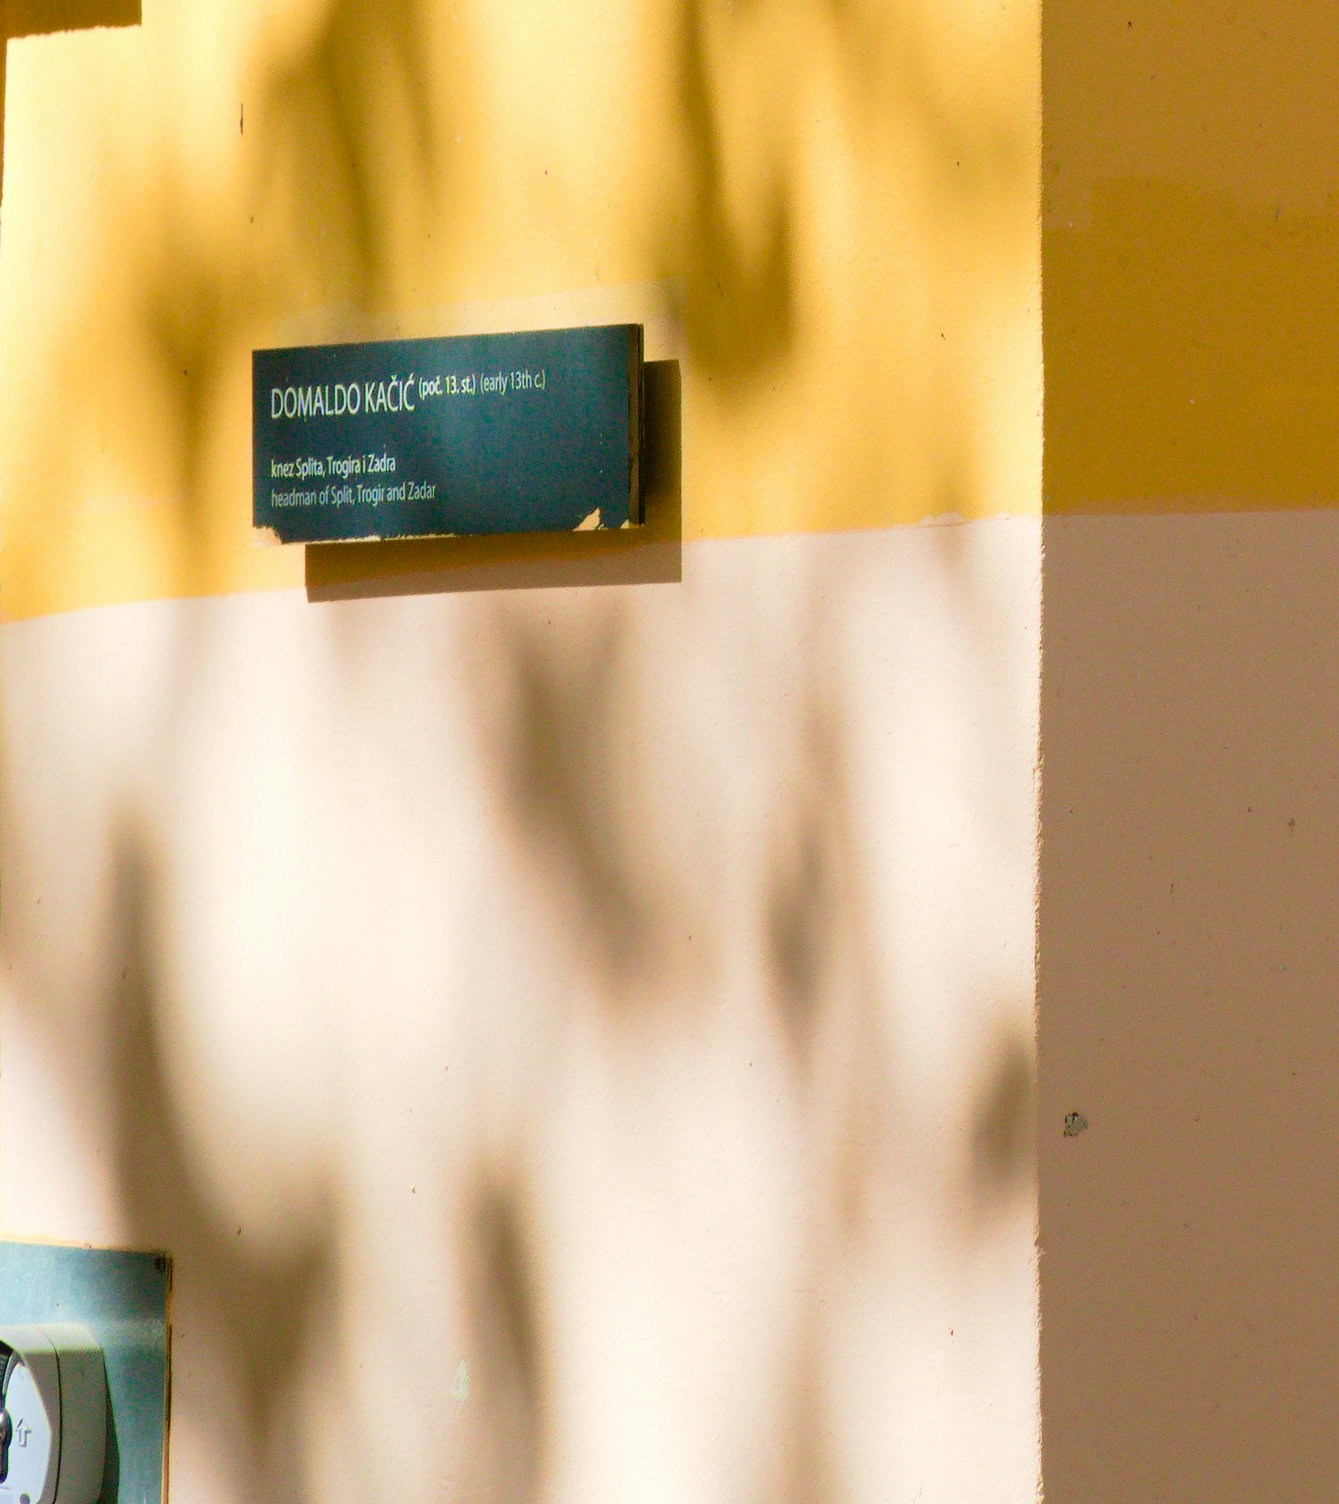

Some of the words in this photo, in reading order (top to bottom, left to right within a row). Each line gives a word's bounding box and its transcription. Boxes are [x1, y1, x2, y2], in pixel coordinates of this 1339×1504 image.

[270, 382, 361, 420] DOMALDO
[364, 372, 416, 414] KAČIĆ
[418, 375, 443, 401] (poč.
[445, 375, 460, 395] 13.
[480, 372, 508, 395] (early
[510, 370, 532, 390] 13th
[270, 459, 295, 478] knez
[295, 456, 326, 481] Splita,
[326, 454, 361, 478] Trogira
[367, 452, 396, 473] Zadra
[270, 487, 317, 508] headman
[318, 486, 331, 506] of
[331, 485, 356, 509] Split,
[356, 483, 387, 507] Trogir
[387, 481, 406, 502] and
[407, 480, 436, 501] Zadar
